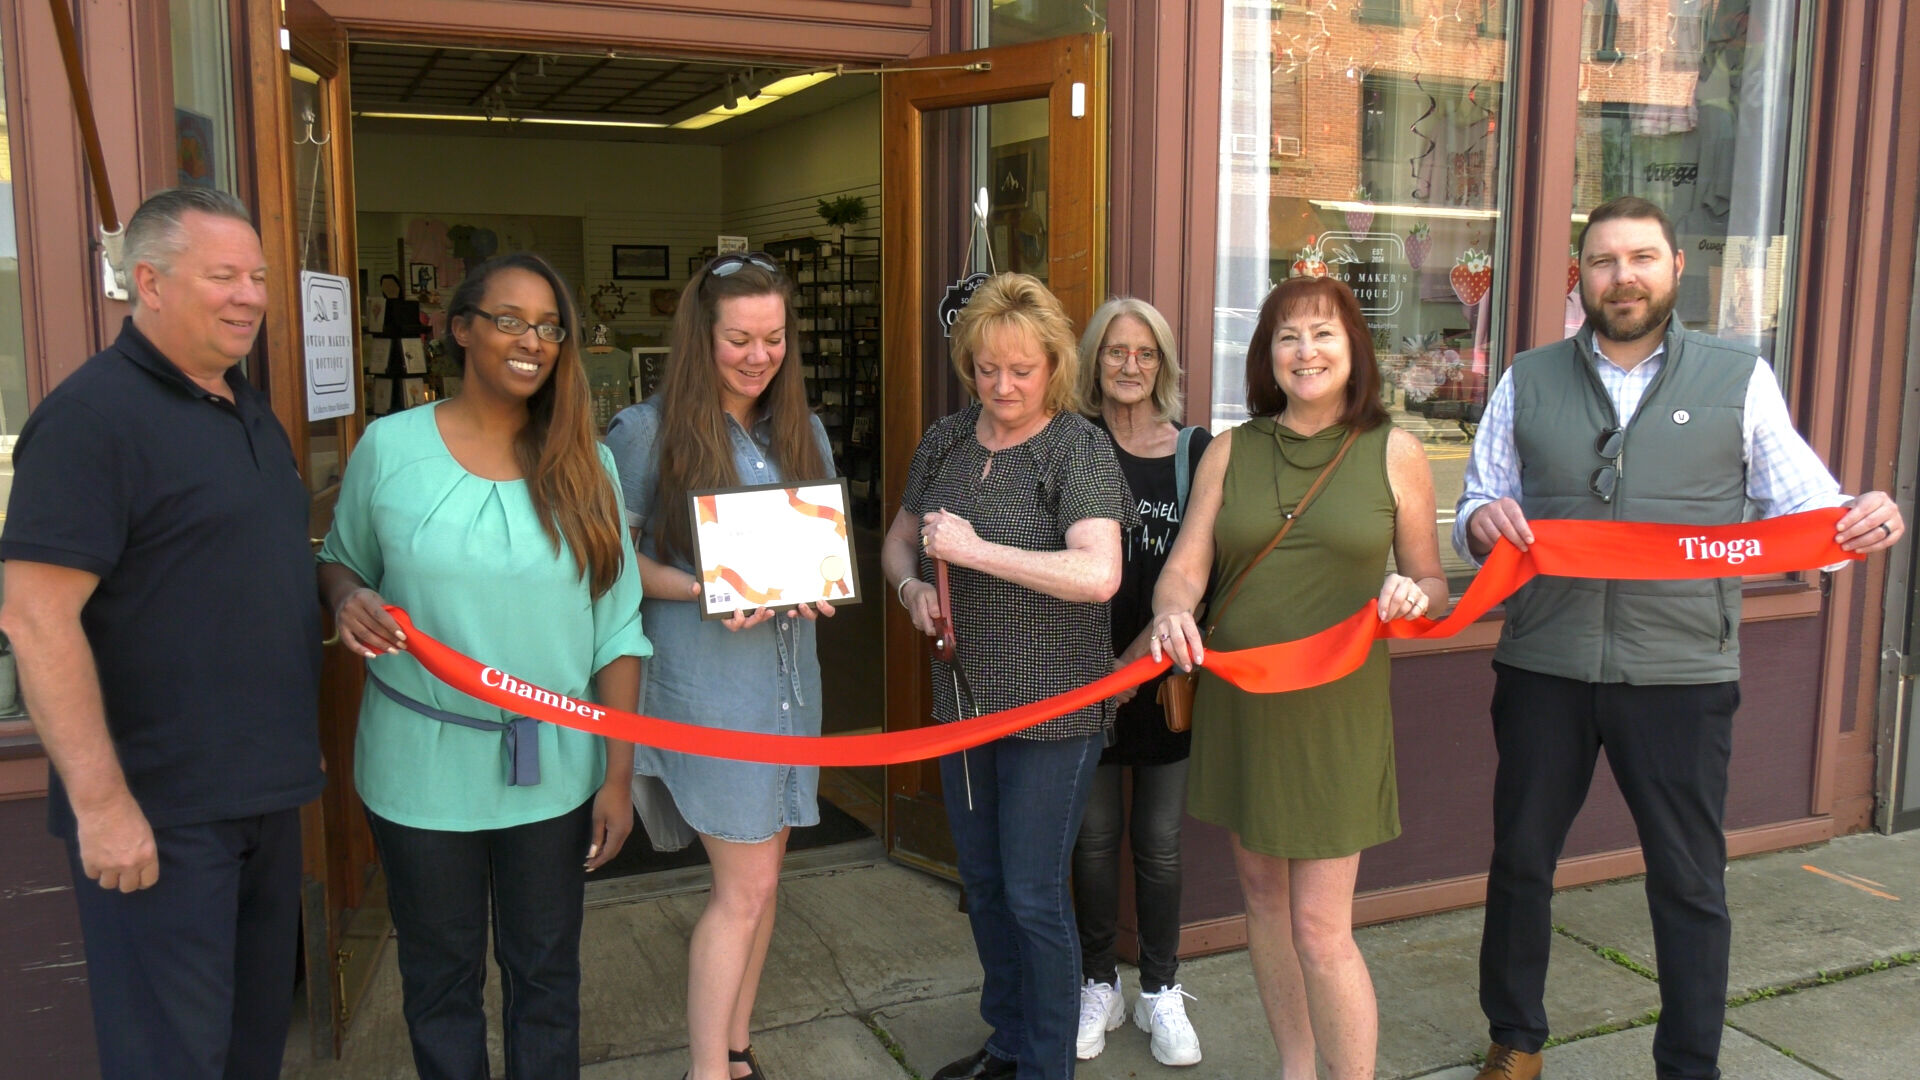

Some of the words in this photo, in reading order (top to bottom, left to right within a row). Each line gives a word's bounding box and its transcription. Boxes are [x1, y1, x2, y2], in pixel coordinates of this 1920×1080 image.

[1358, 273, 1407, 283] MAKER'S
[1353, 289, 1389, 300] TIQUE
[1678, 535, 1763, 564] Tioga
[481, 666, 606, 721] Chamber
